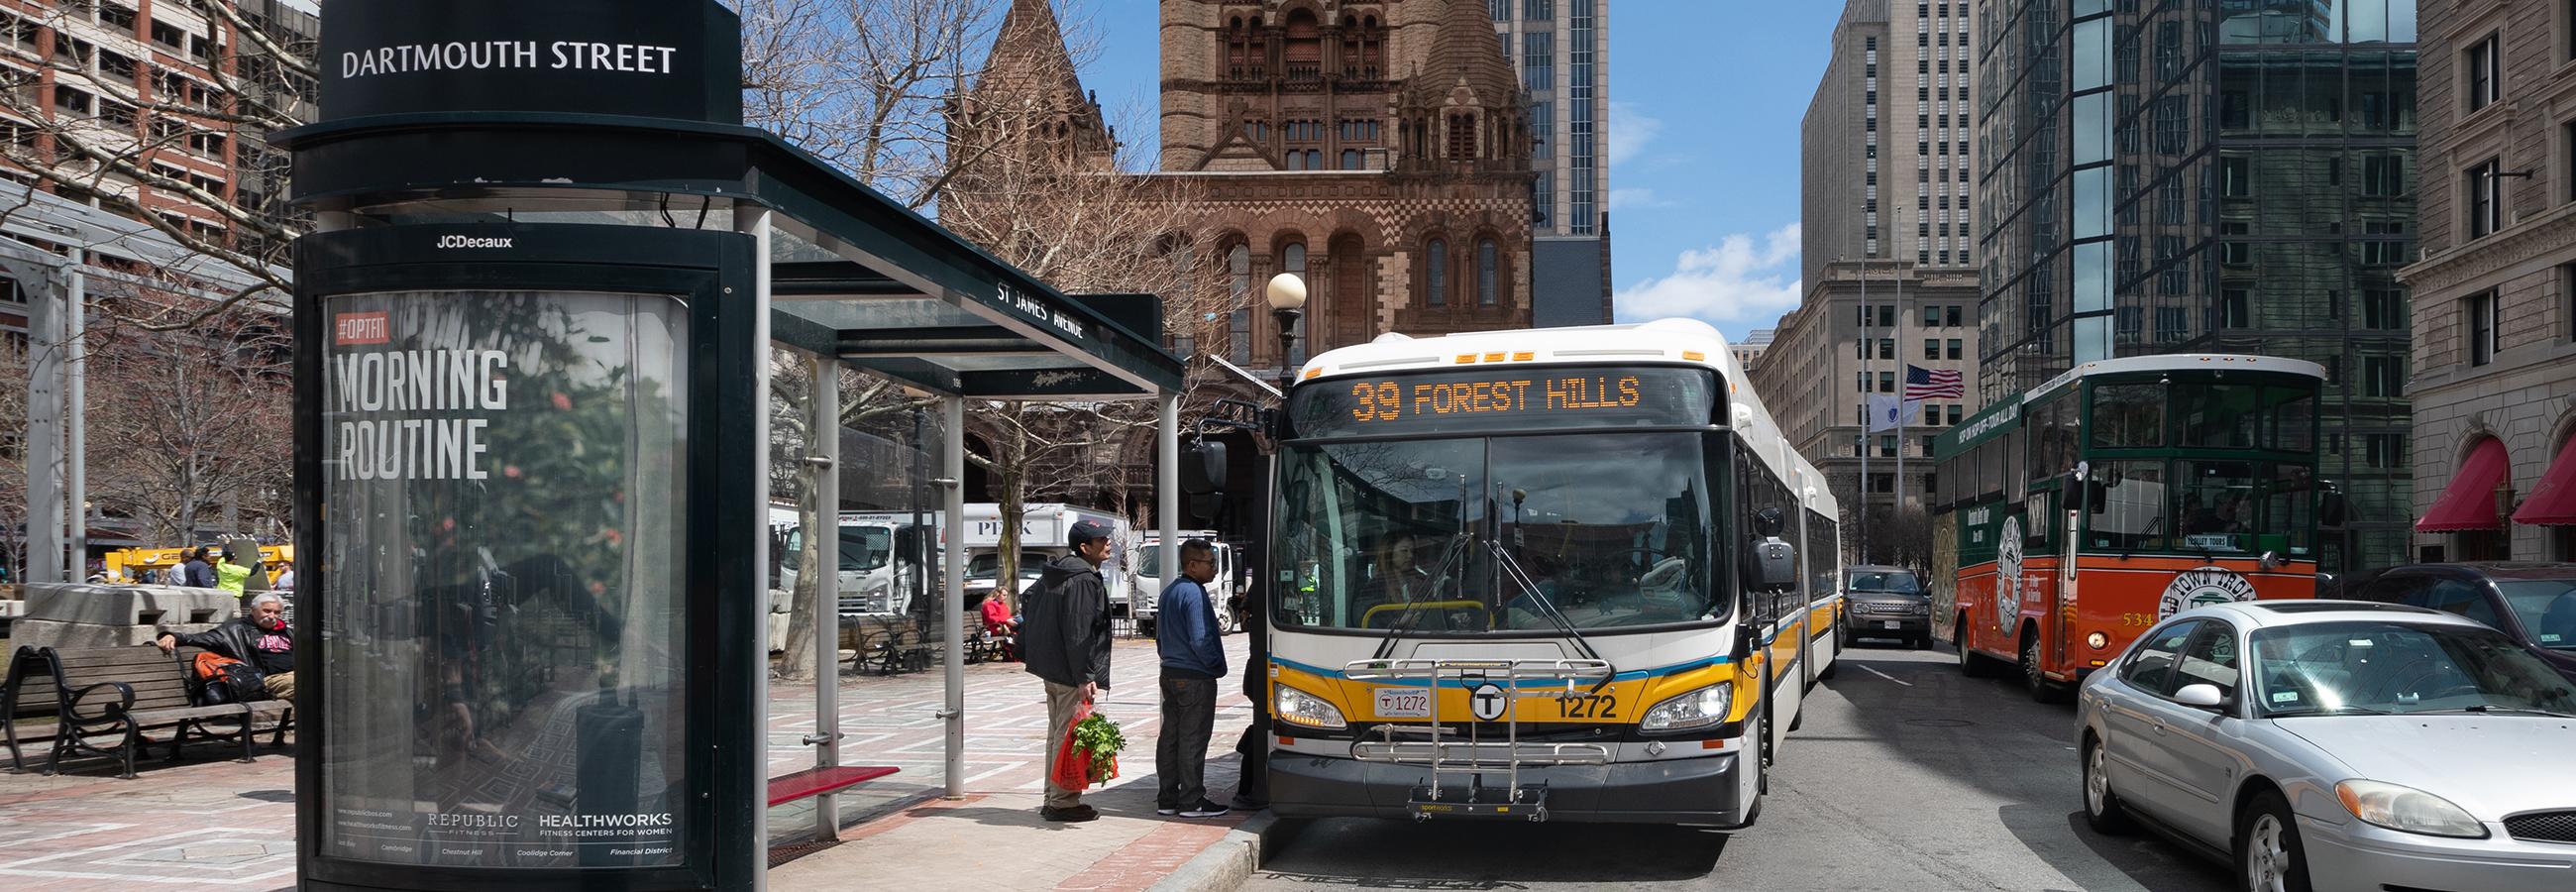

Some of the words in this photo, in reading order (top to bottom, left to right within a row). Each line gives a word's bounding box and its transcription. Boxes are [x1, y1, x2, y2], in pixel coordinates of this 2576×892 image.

[342, 41, 537, 78] DARTMOUTH
[551, 41, 677, 73] STREET
[437, 235, 513, 249] JCDecaux
[997, 281, 1011, 303] ST
[1015, 290, 1047, 321] JAMES
[1053, 309, 1084, 339] AVENUE
[338, 316, 385, 340] #OPTFIT
[336, 349, 507, 412] MORNING
[1351, 381, 1401, 421] 39
[1414, 380, 1531, 414] FOREST
[1546, 376, 1640, 411] HILLS
[340, 418, 487, 481] ROUTINE
[978, 521, 1032, 535] PEK
[2209, 537, 2225, 546] TOURS
[2171, 568, 2212, 597] TOWN
[2123, 613, 2154, 625] 534
[1396, 696, 1427, 711] 1272
[1476, 693, 1500, 715] T
[1555, 695, 1617, 719] 1272
[428, 813, 518, 828] REPUBLIC
[539, 813, 673, 828] HEALTHWORKS
[380, 843, 413, 853] Cambridge
[441, 847, 471, 856] Chestnut
[516, 849, 548, 858] Coolidge
